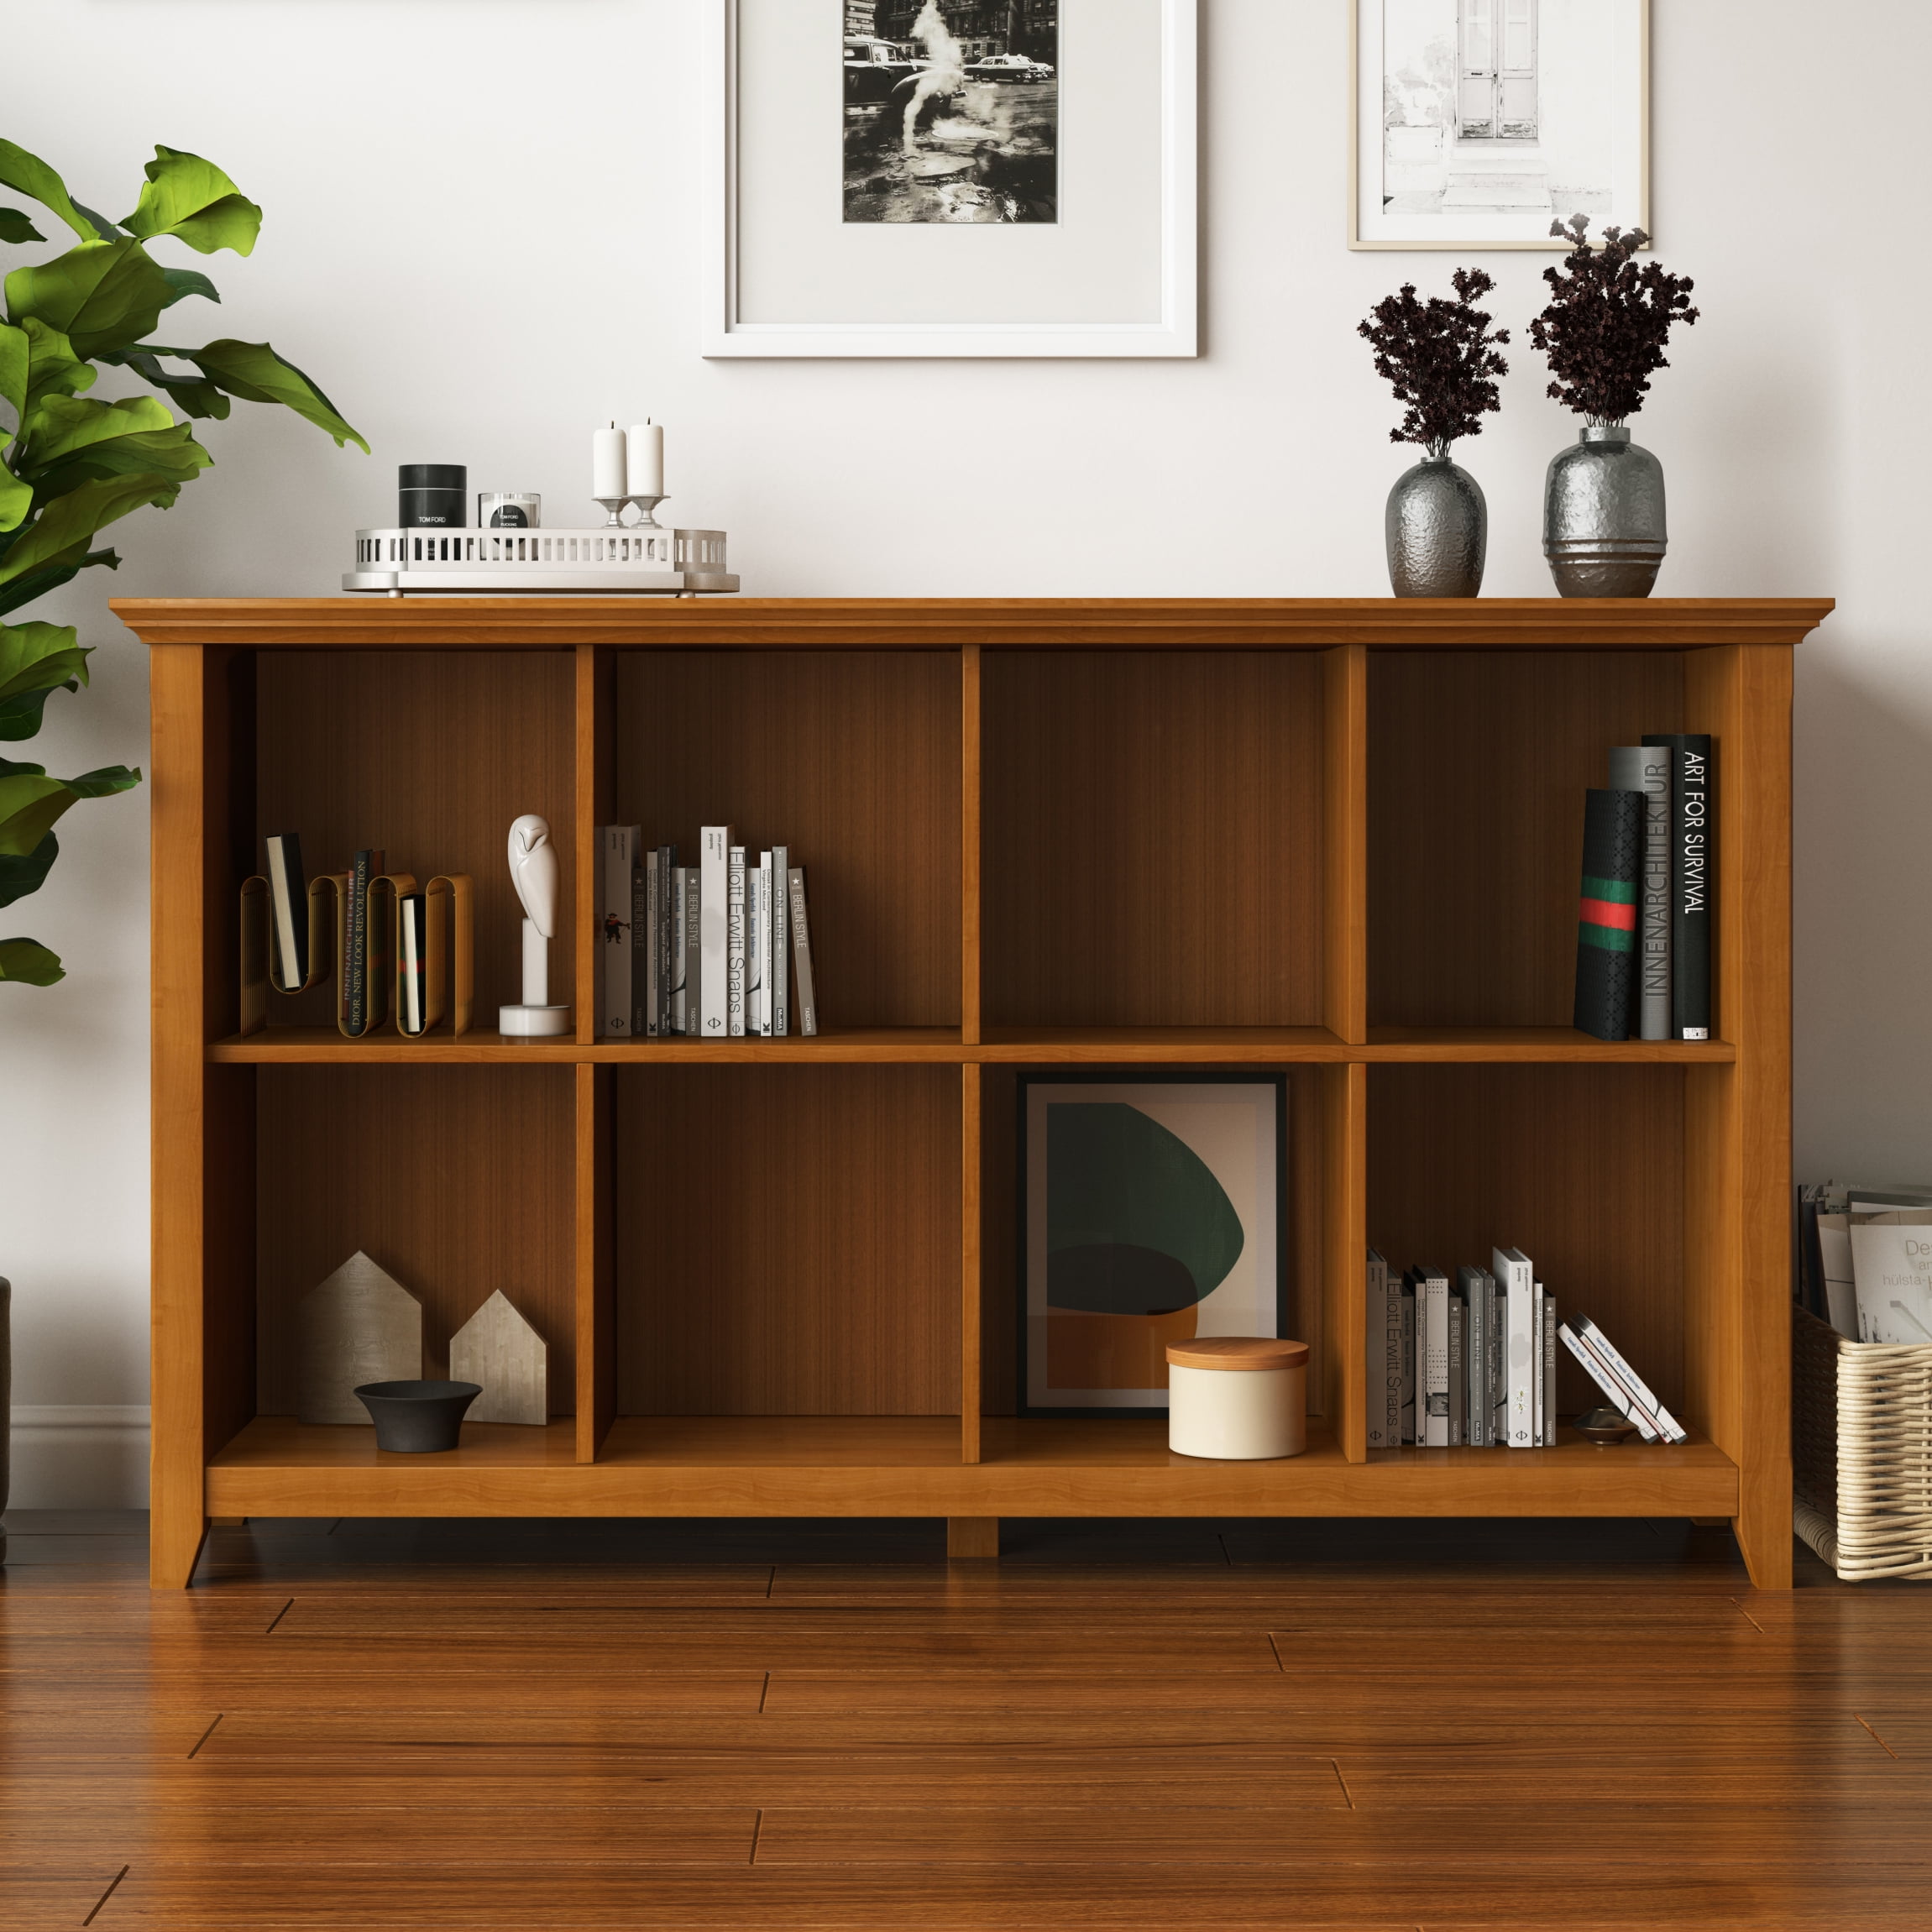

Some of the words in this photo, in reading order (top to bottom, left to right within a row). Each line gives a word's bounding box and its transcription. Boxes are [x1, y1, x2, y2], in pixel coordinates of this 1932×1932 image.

[1684, 751, 1705, 785] ART
[1684, 792, 1705, 827] FOR
[729, 852, 744, 897] Elliott
[1645, 763, 1668, 997] INNENARCHITEKTUR
[1684, 834, 1705, 914] SURVIVAL
[356, 860, 366, 932] REVOLUTION
[635, 893, 643, 922] BERLIN
[689, 893, 698, 922] BERLIN
[776, 889, 784, 908] ON
[793, 894, 804, 922] BERLIN
[344, 877, 354, 1001] INNENARCHITEKTUR
[635, 924, 643, 947] STYLE
[689, 924, 698, 947] STYLE
[729, 903, 744, 950] Erwitt
[776, 915, 784, 945] LINE
[796, 924, 806, 948] STYLE
[354, 935, 363, 966] LOOK
[353, 969, 362, 992] NEW
[729, 957, 744, 1013] Snaps
[352, 996, 361, 1025] DIOR.
[1387, 1283, 1401, 1323] Elliott
[1451, 1320, 1459, 1345] BERLIN
[1474, 1317, 1481, 1333] ON
[1545, 1320, 1553, 1345] BERLIN
[1387, 1329, 1401, 1370] Erwitt
[1451, 1347, 1459, 1369] STYLE
[1545, 1347, 1553, 1369] STYLE
[1387, 1376, 1401, 1426] Snaps
